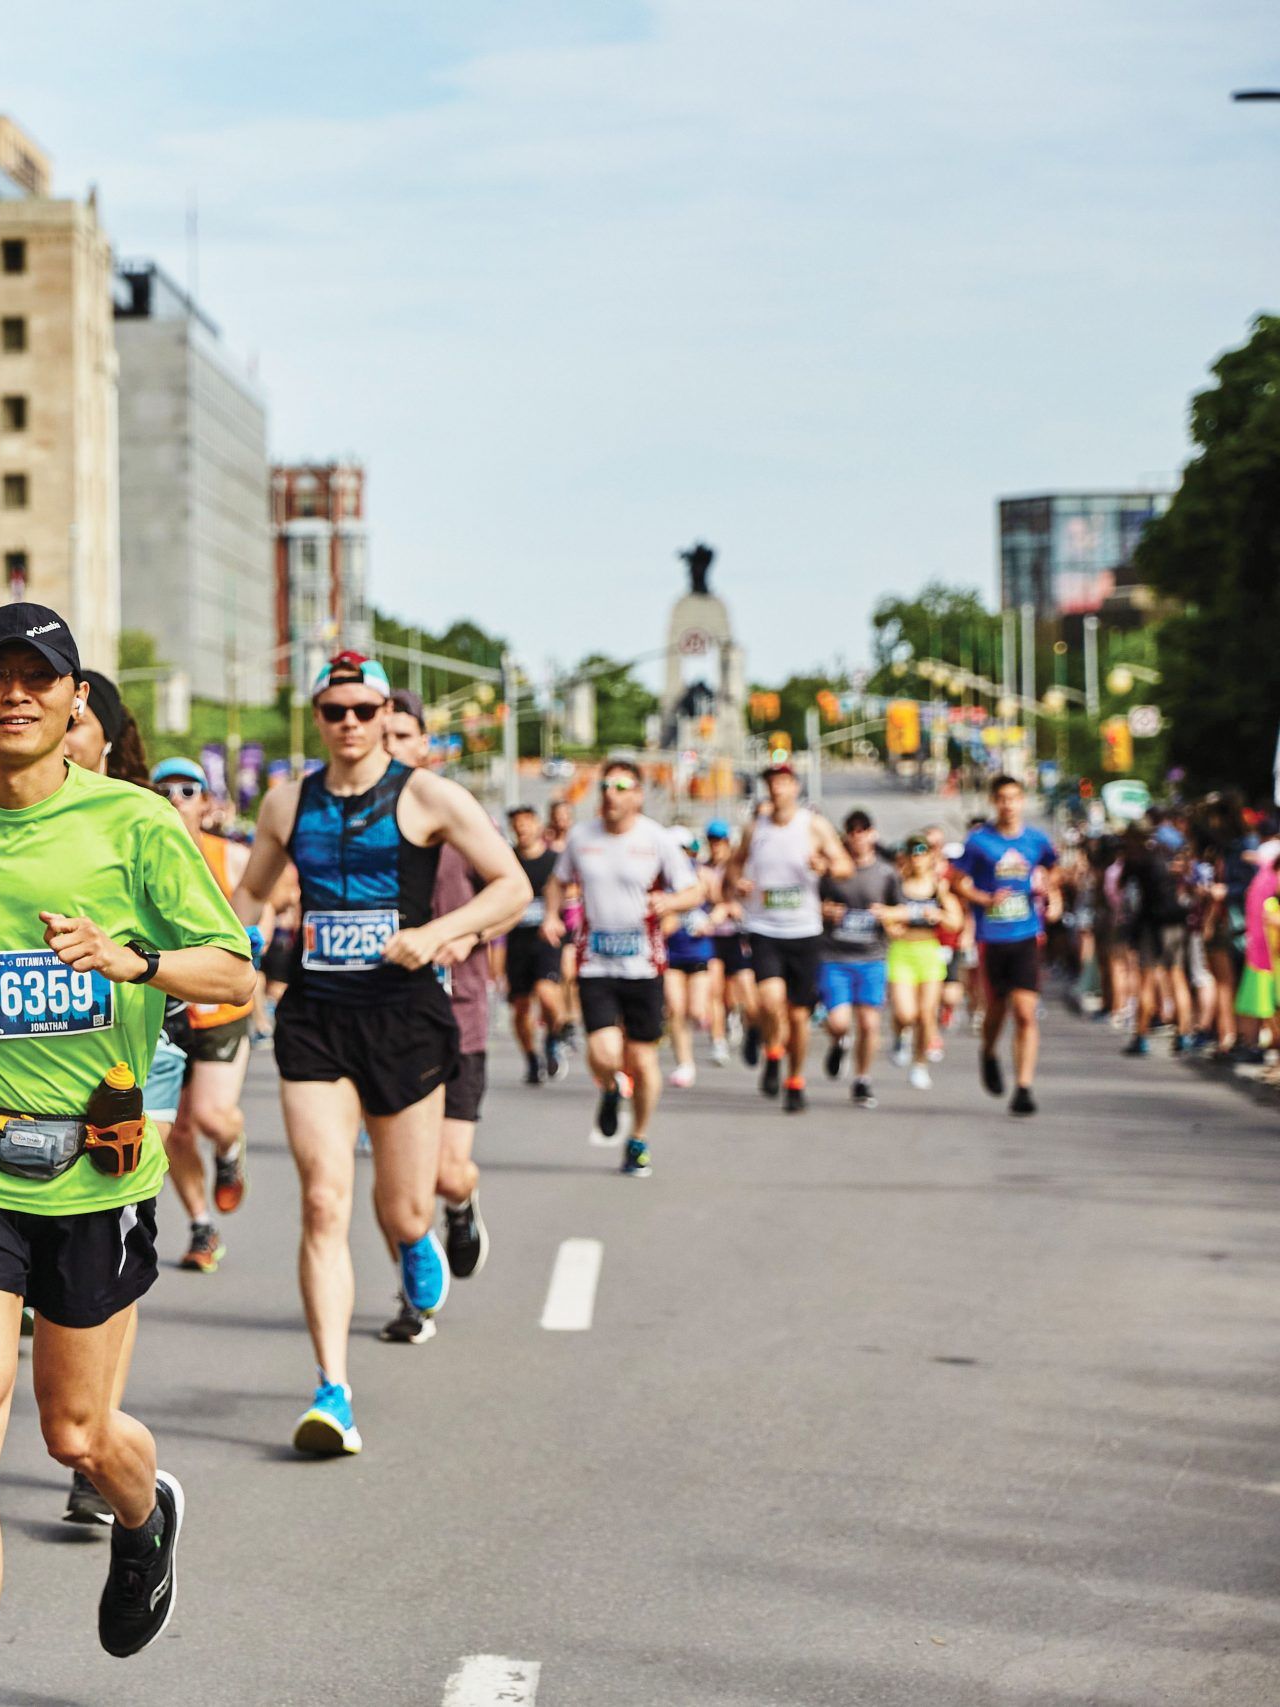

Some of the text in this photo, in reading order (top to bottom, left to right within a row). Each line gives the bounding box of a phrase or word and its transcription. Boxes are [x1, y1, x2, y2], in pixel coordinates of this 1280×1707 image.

[33, 621, 61, 634] Columbia
[320, 923, 393, 957] 12253
[15, 957, 44, 968] OTTAWA
[0, 970, 93, 1017] 6359
[30, 1021, 68, 1033] JONATHAN
